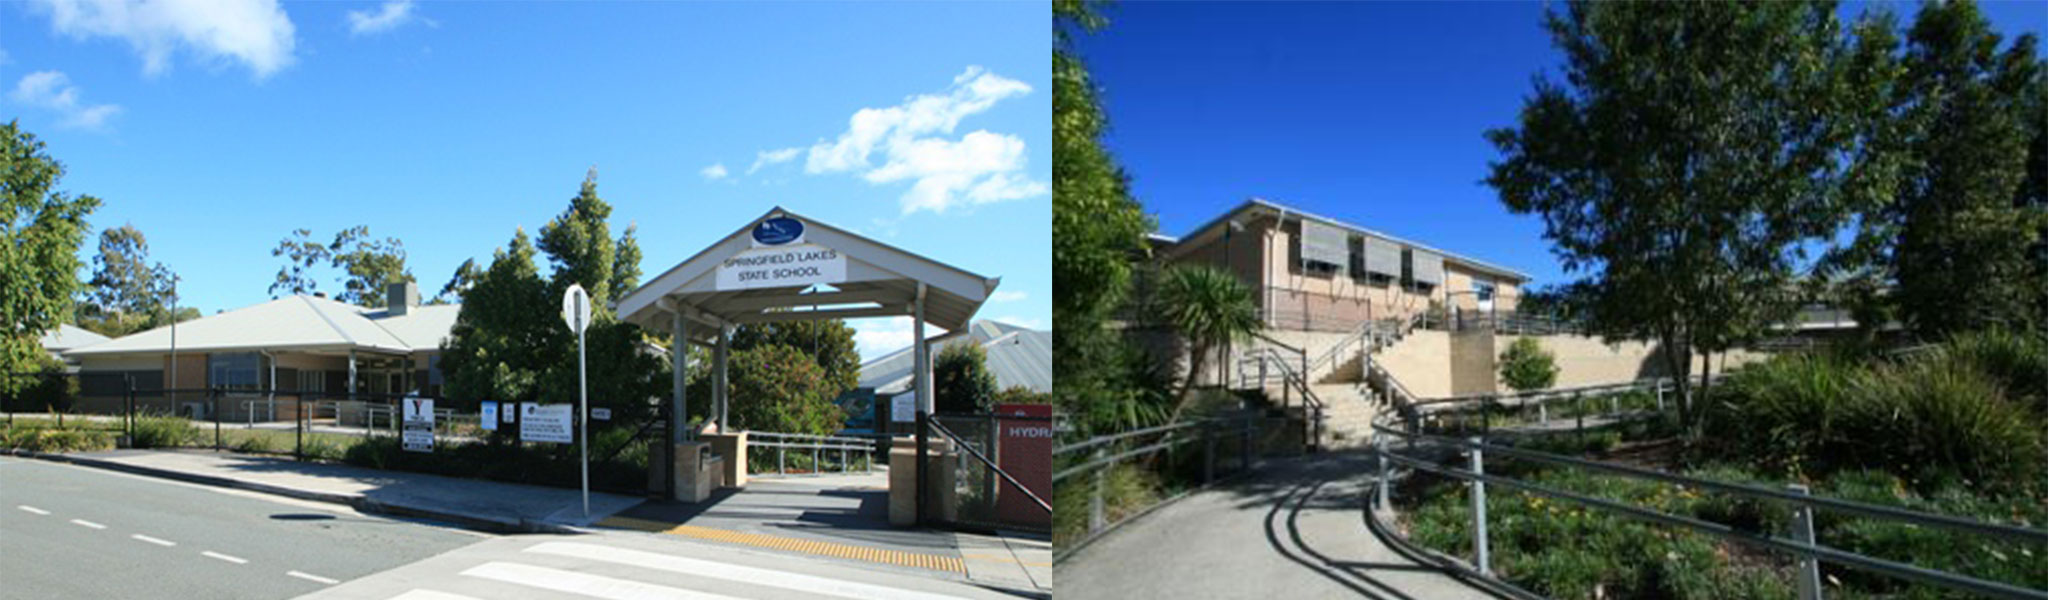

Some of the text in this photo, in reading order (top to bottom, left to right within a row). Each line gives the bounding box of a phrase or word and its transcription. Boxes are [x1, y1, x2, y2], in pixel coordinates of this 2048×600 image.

[724, 249, 837, 267] SPRINGFIELD LAKES
[738, 266, 821, 281] STATE SCHOOL
